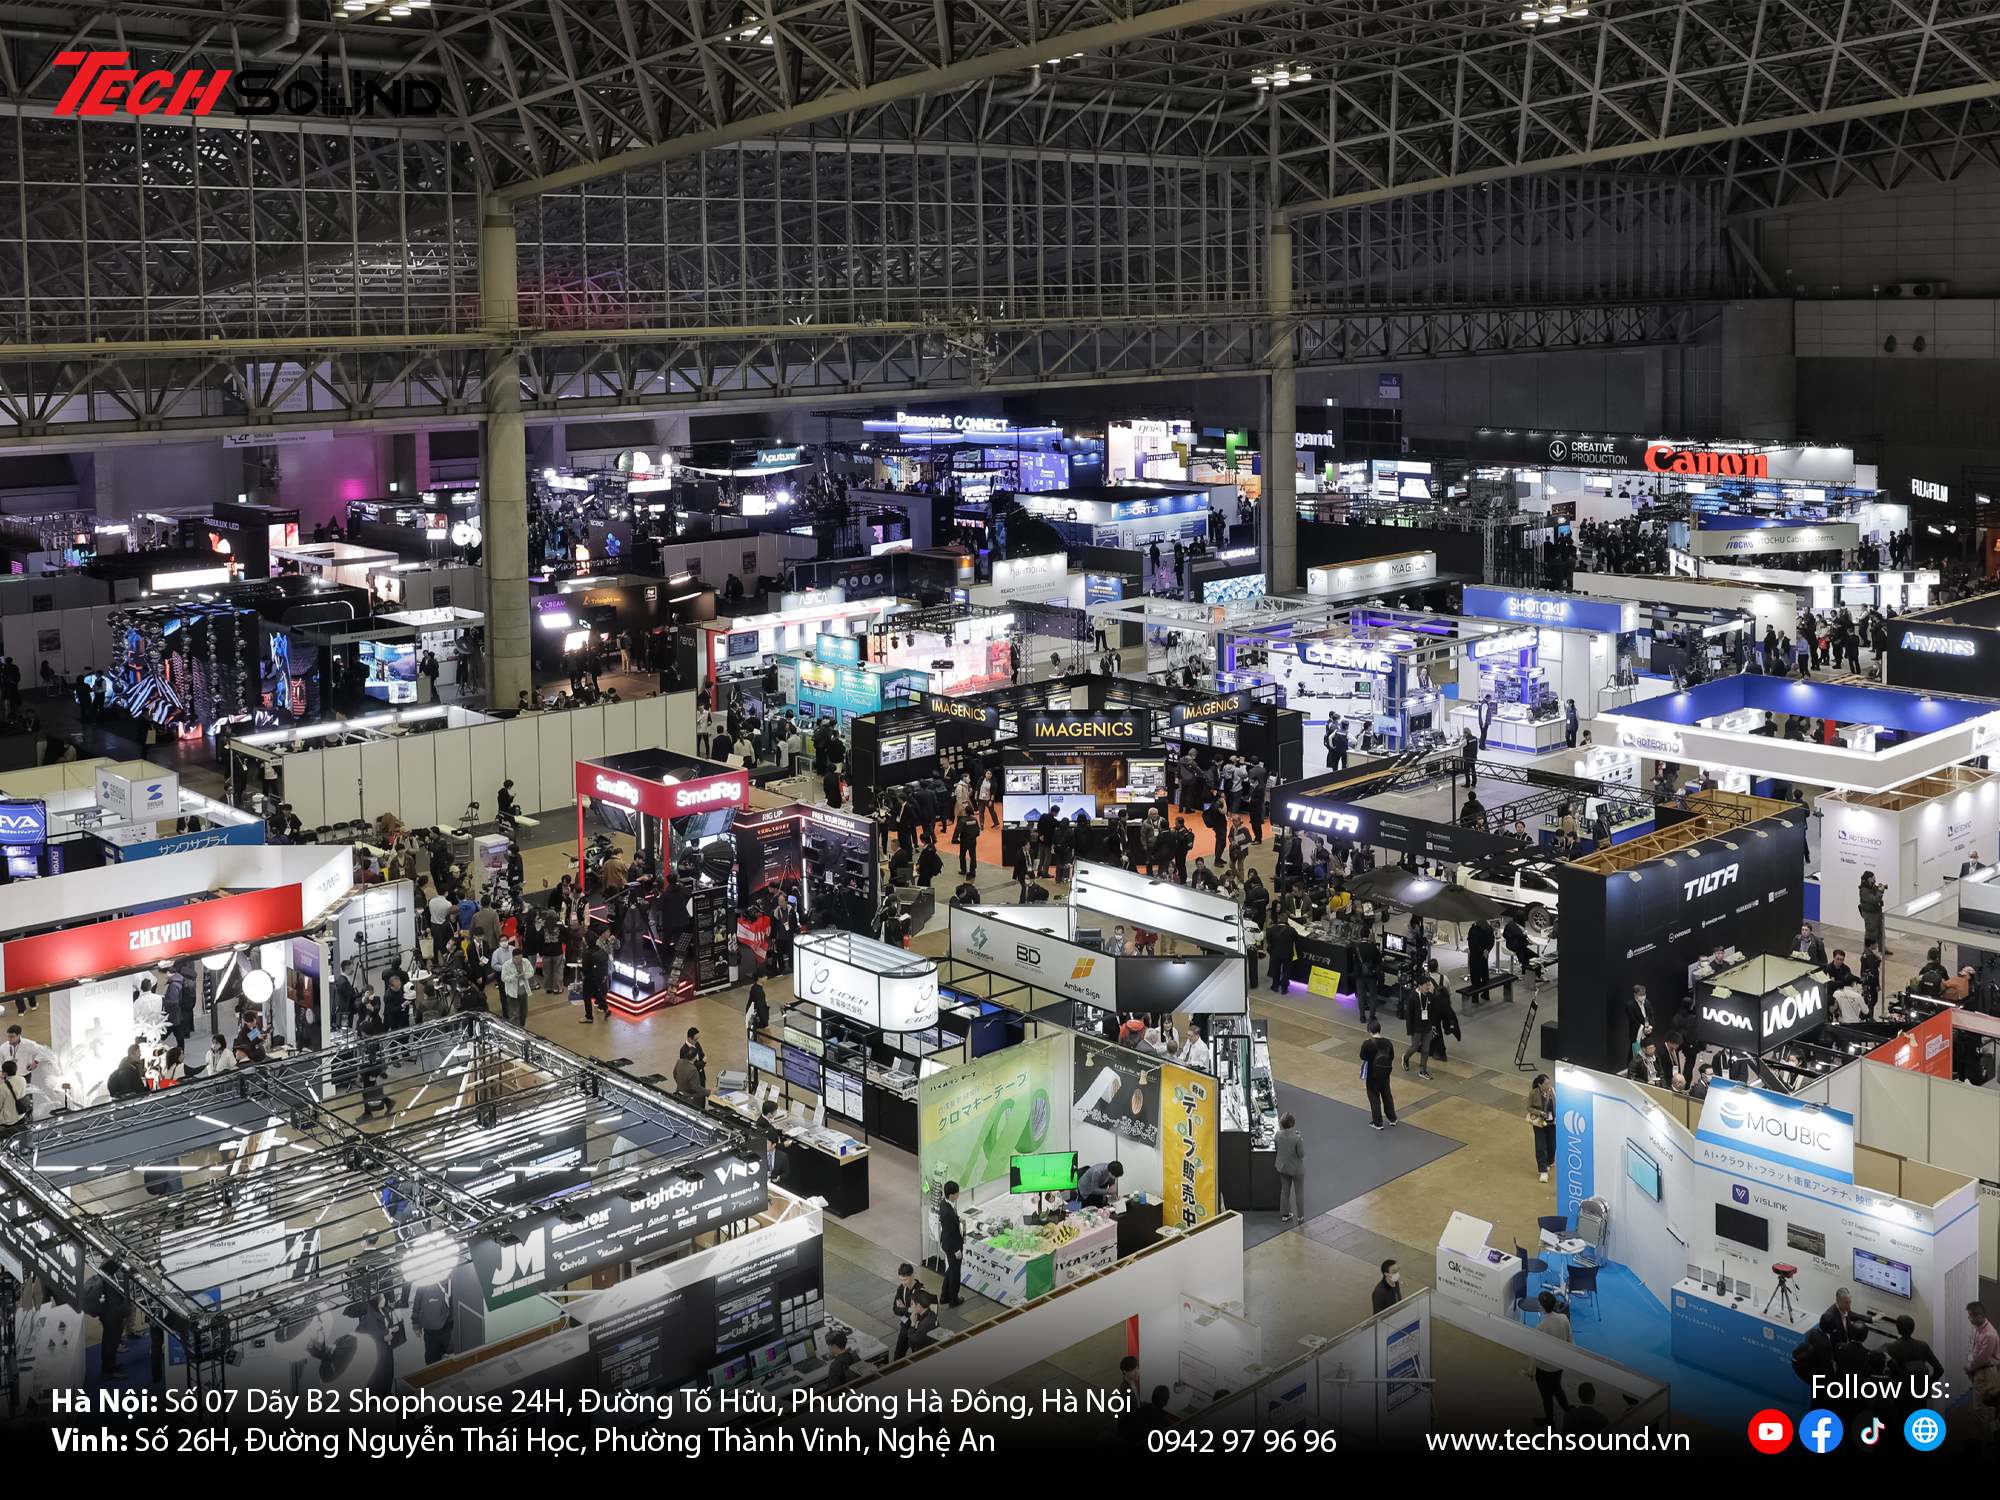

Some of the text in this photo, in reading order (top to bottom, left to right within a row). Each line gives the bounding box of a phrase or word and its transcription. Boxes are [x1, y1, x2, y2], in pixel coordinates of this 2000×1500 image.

[896, 411, 952, 430] Panasonic
[760, 452, 798, 464] Aputure
[1571, 441, 1615, 454] CREATIVE
[1571, 452, 1629, 465] PRODUCTION
[1644, 444, 1768, 479] Canon
[1911, 478, 1949, 503] FUJIFILM
[1509, 597, 1566, 617] SHOTOKU
[1475, 629, 1540, 657] COSMIC
[1305, 643, 1394, 674] COSMIC
[932, 700, 986, 723] IMAGENICS
[1183, 696, 1240, 719] IMAGENICS
[1035, 722, 1134, 737] IMAGENICS
[596, 774, 639, 805] SmallRig
[676, 777, 742, 808] SmallRig
[762, 810, 784, 822] RIG UP
[1286, 802, 1360, 834] TILTA
[158, 833, 229, 857] サンワサプライ
[1683, 862, 1740, 902] TILTA
[128, 919, 192, 951] ZHIYUN
[1302, 951, 1331, 965] TILTA
[829, 987, 871, 1007] EIDEN
[1064, 981, 1101, 1000] Amber Sign
[937, 1071, 1029, 1132] クロマキーテープ
[1747, 1109, 1832, 1152] MOUBIC
[1565, 1135, 1585, 1214] MOUBIC
[560, 1255, 588, 1273] Quividi
[1820, 1258, 1841, 1271] Sports
